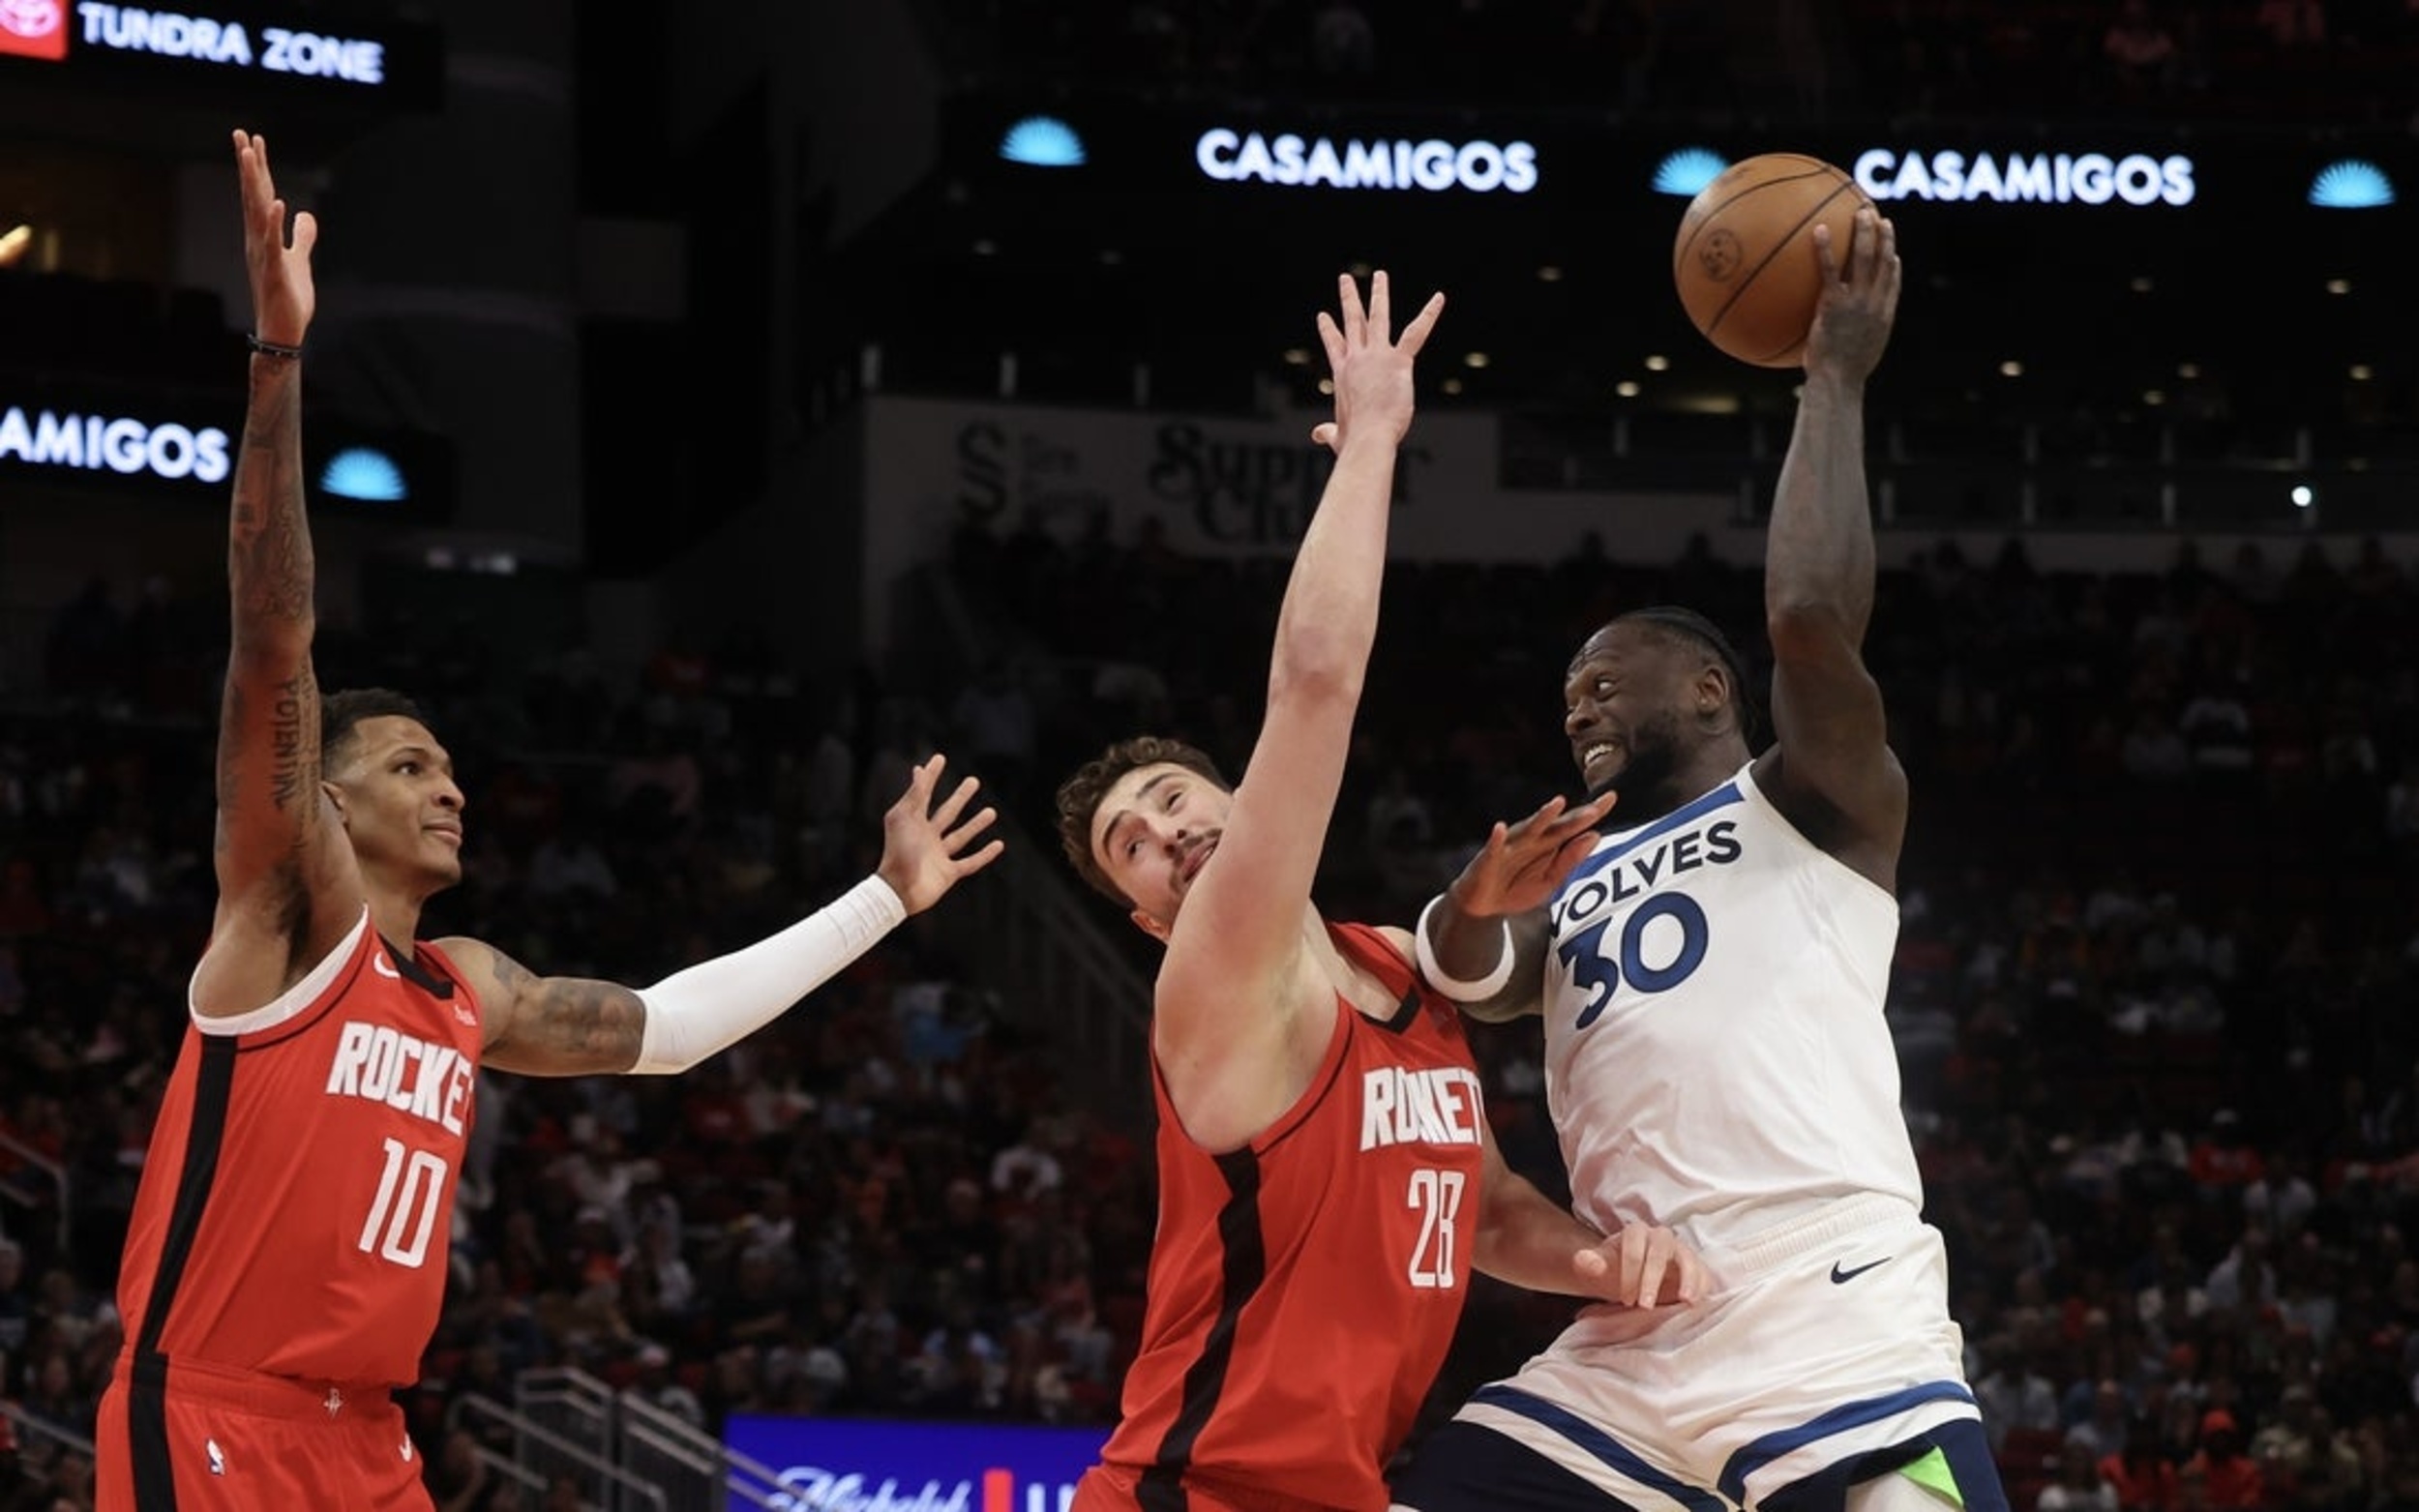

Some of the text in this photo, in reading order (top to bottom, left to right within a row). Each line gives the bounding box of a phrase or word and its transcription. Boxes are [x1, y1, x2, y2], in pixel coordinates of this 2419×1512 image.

[77, 1, 384, 84] TUNDRA ZONE
[1196, 128, 1538, 193] CASAMIGOS
[1853, 148, 2196, 206] CASAMIGOS
[1149, 423, 1434, 507] Supr
[1558, 891, 1709, 1030] 30
[358, 1137, 447, 1269] 10
